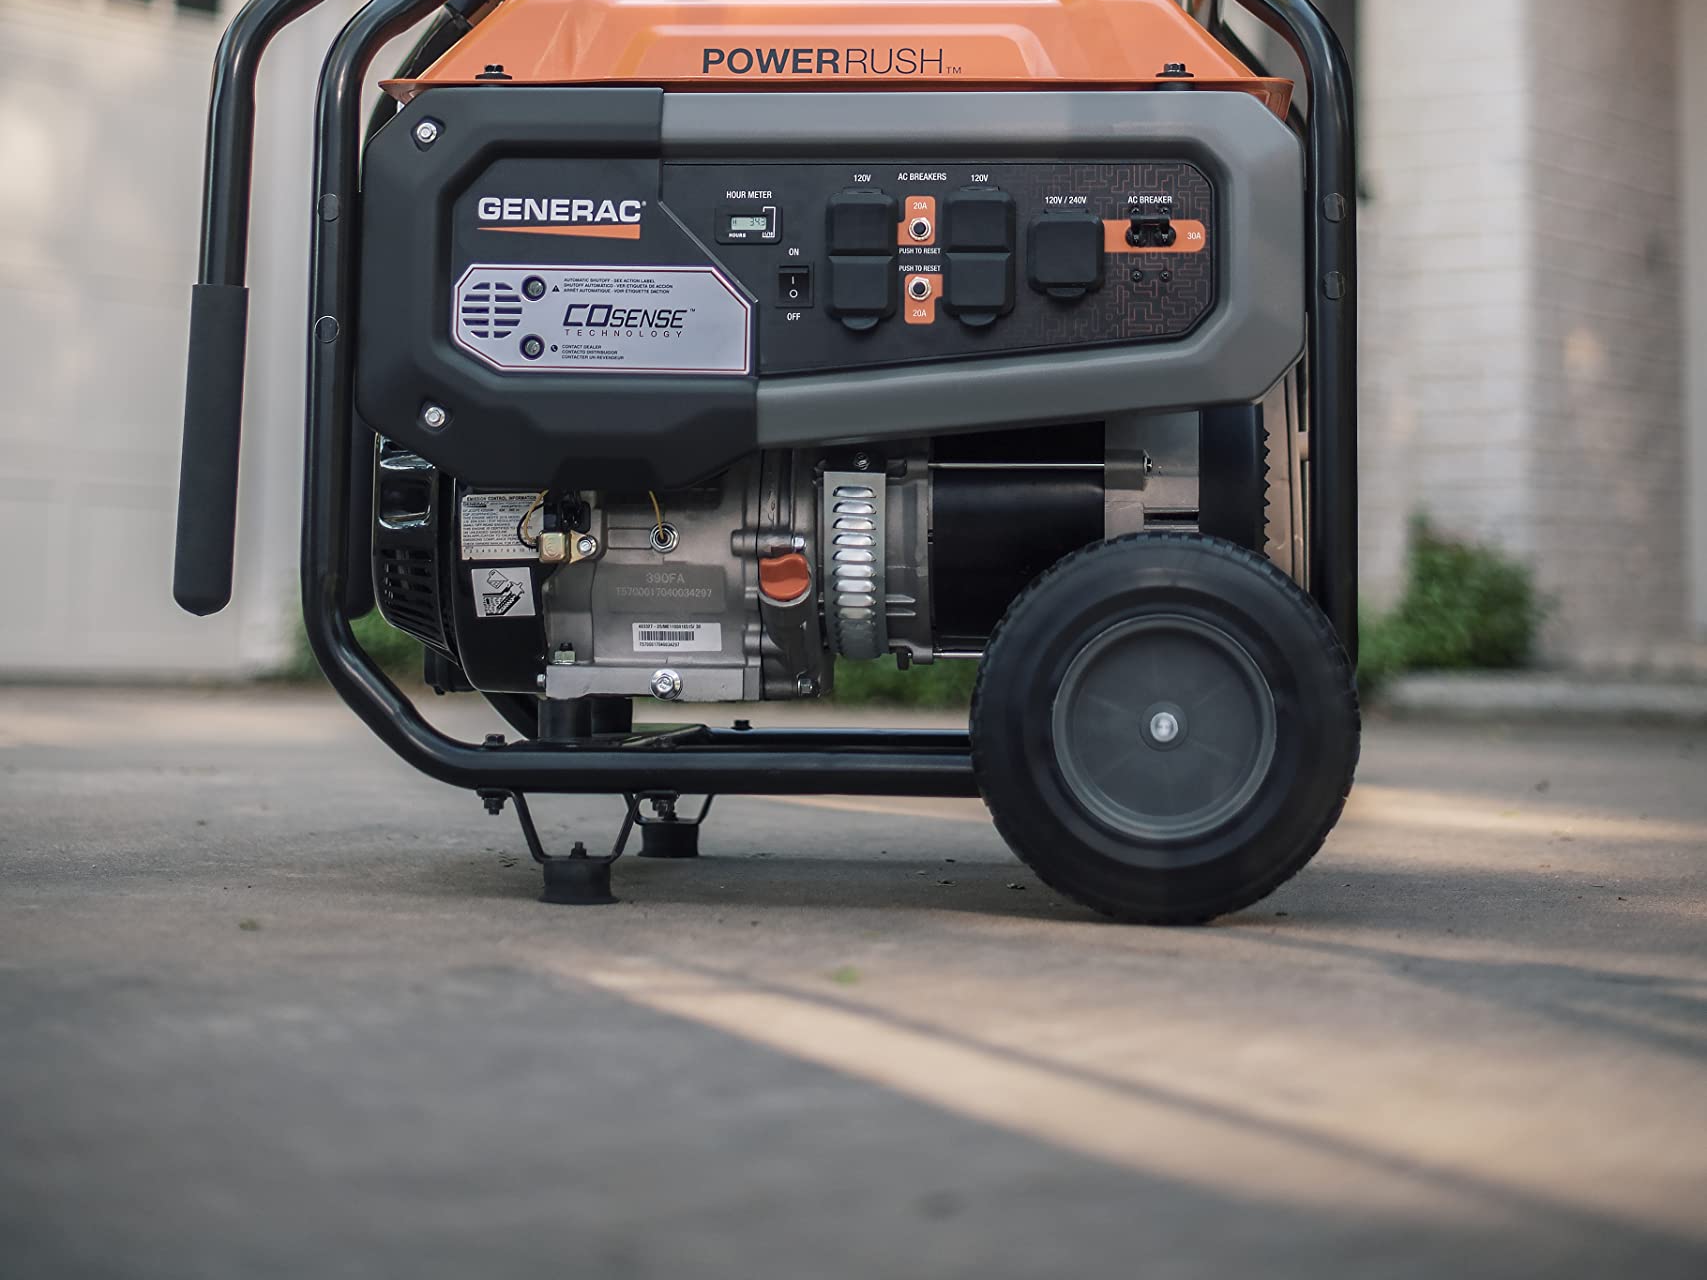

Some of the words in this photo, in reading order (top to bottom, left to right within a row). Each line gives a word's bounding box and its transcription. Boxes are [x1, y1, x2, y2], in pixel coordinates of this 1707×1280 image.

[853, 174, 872, 182] 120V
[897, 173, 908, 181] AC
[909, 172, 948, 181] BREAKERS
[971, 174, 989, 182] 120V
[726, 190, 746, 199] HOUR
[747, 190, 772, 199] METER
[1045, 195, 1063, 205] 120V
[1068, 195, 1087, 205] 240V
[1127, 195, 1138, 204] AC
[1139, 195, 1173, 204] BREAKER
[478, 197, 641, 223] GENERAC
[913, 202, 928, 210] 20A
[1186, 231, 1202, 240] 30A
[788, 247, 800, 256] ON
[898, 264, 914, 272] PUSH
[915, 264, 923, 272] TO
[923, 264, 941, 272] RESET
[786, 312, 801, 321] OFF
[912, 309, 927, 317] 20A
[564, 329, 682, 338] TECHNOLOGY
[646, 572, 685, 584] 390FA
